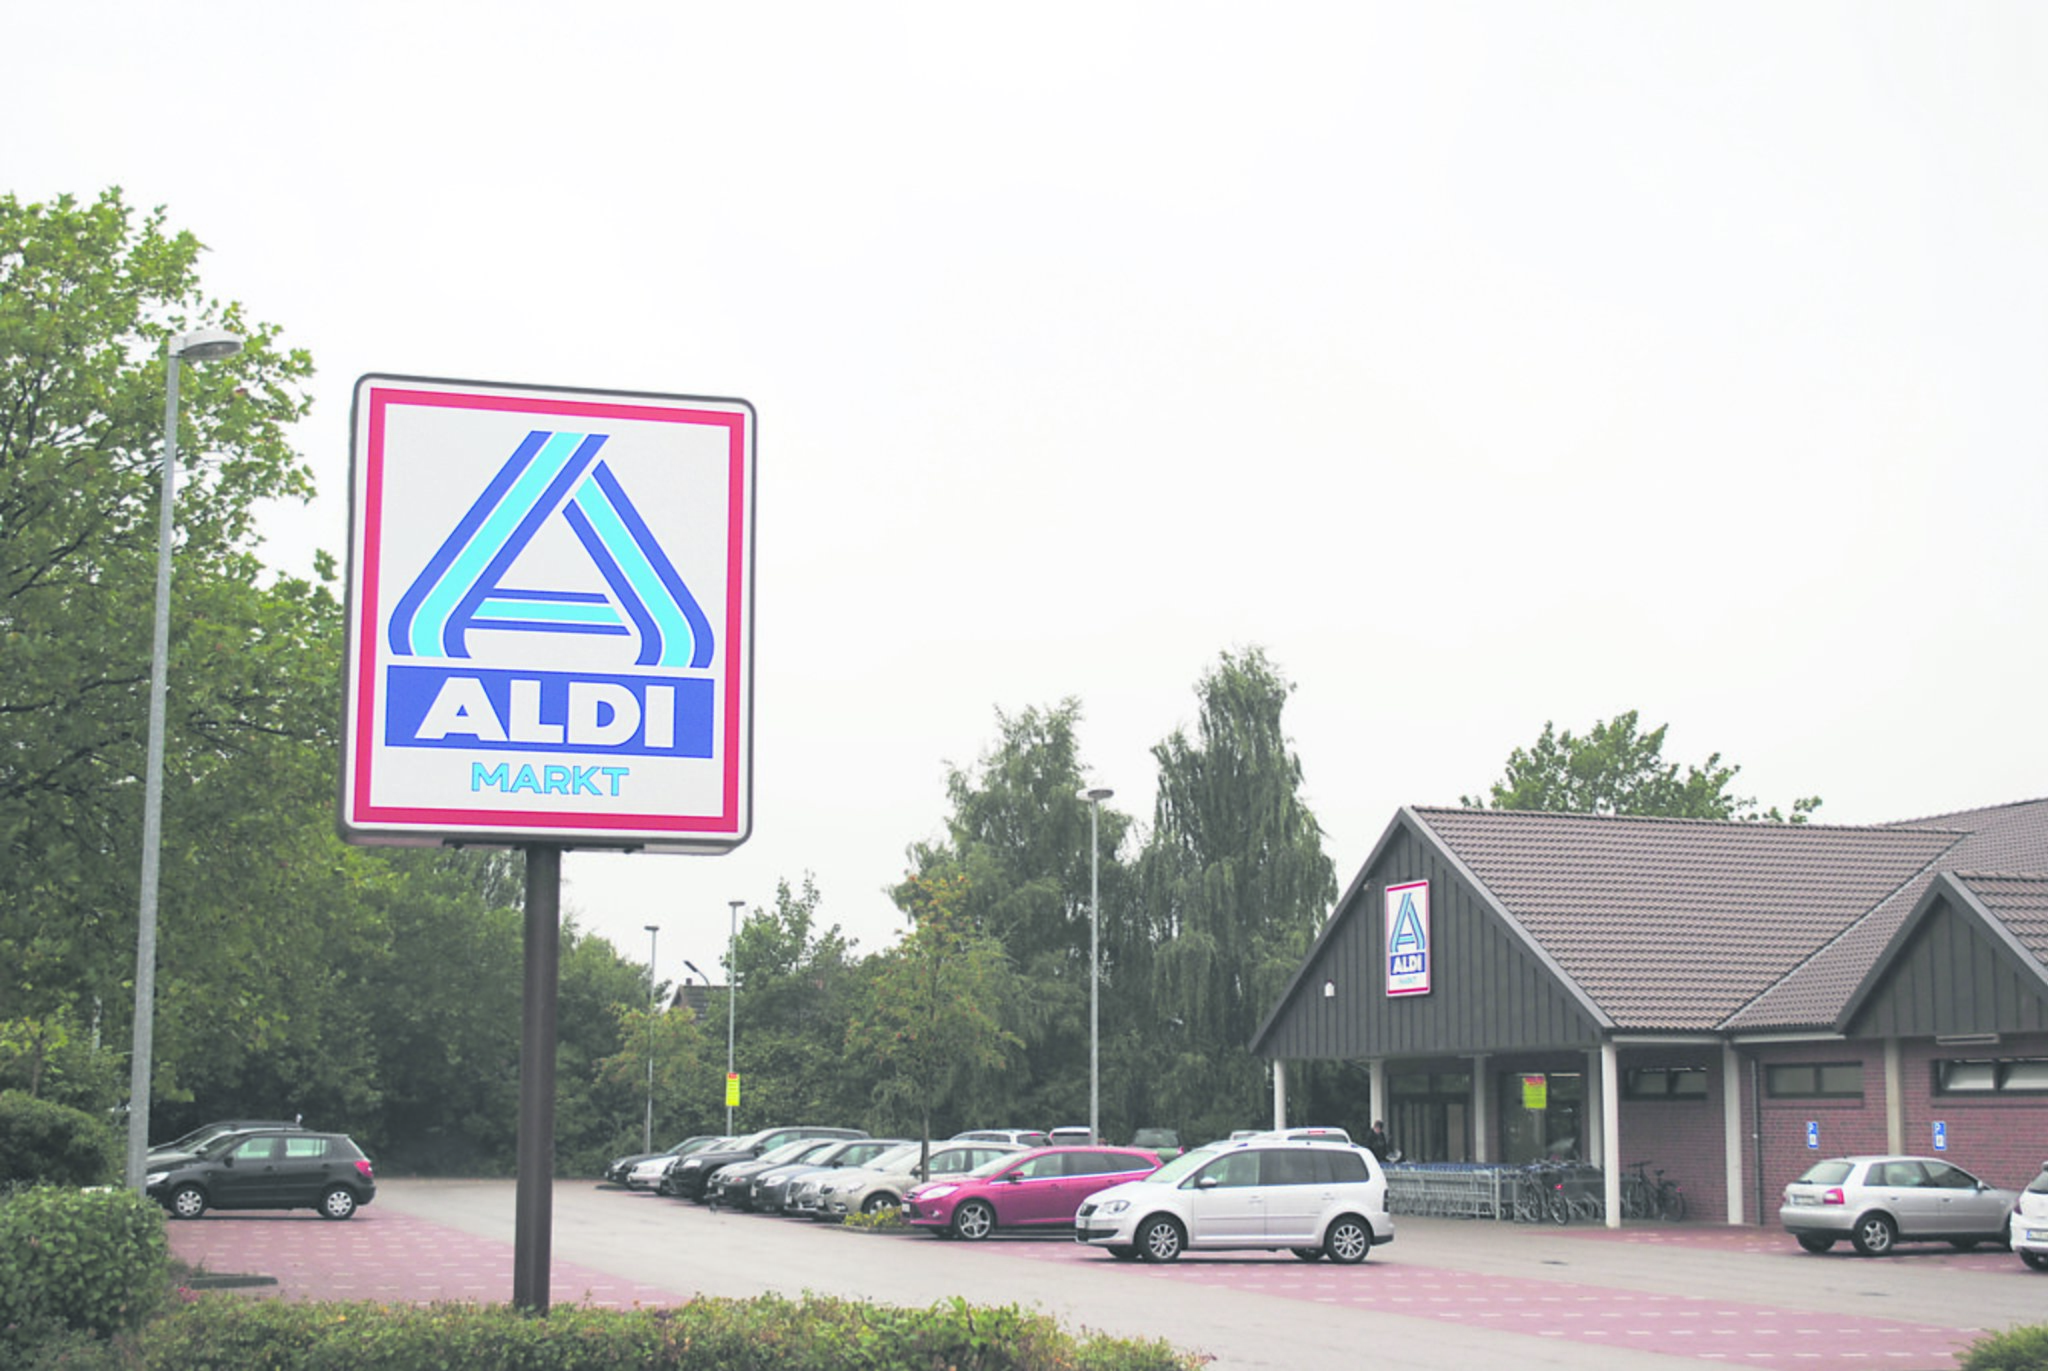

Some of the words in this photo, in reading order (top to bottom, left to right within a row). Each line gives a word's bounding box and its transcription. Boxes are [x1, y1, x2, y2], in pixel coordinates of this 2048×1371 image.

[414, 676, 676, 749] ALDI
[470, 762, 630, 797] MARKT
[1392, 954, 1423, 975] ALDI
